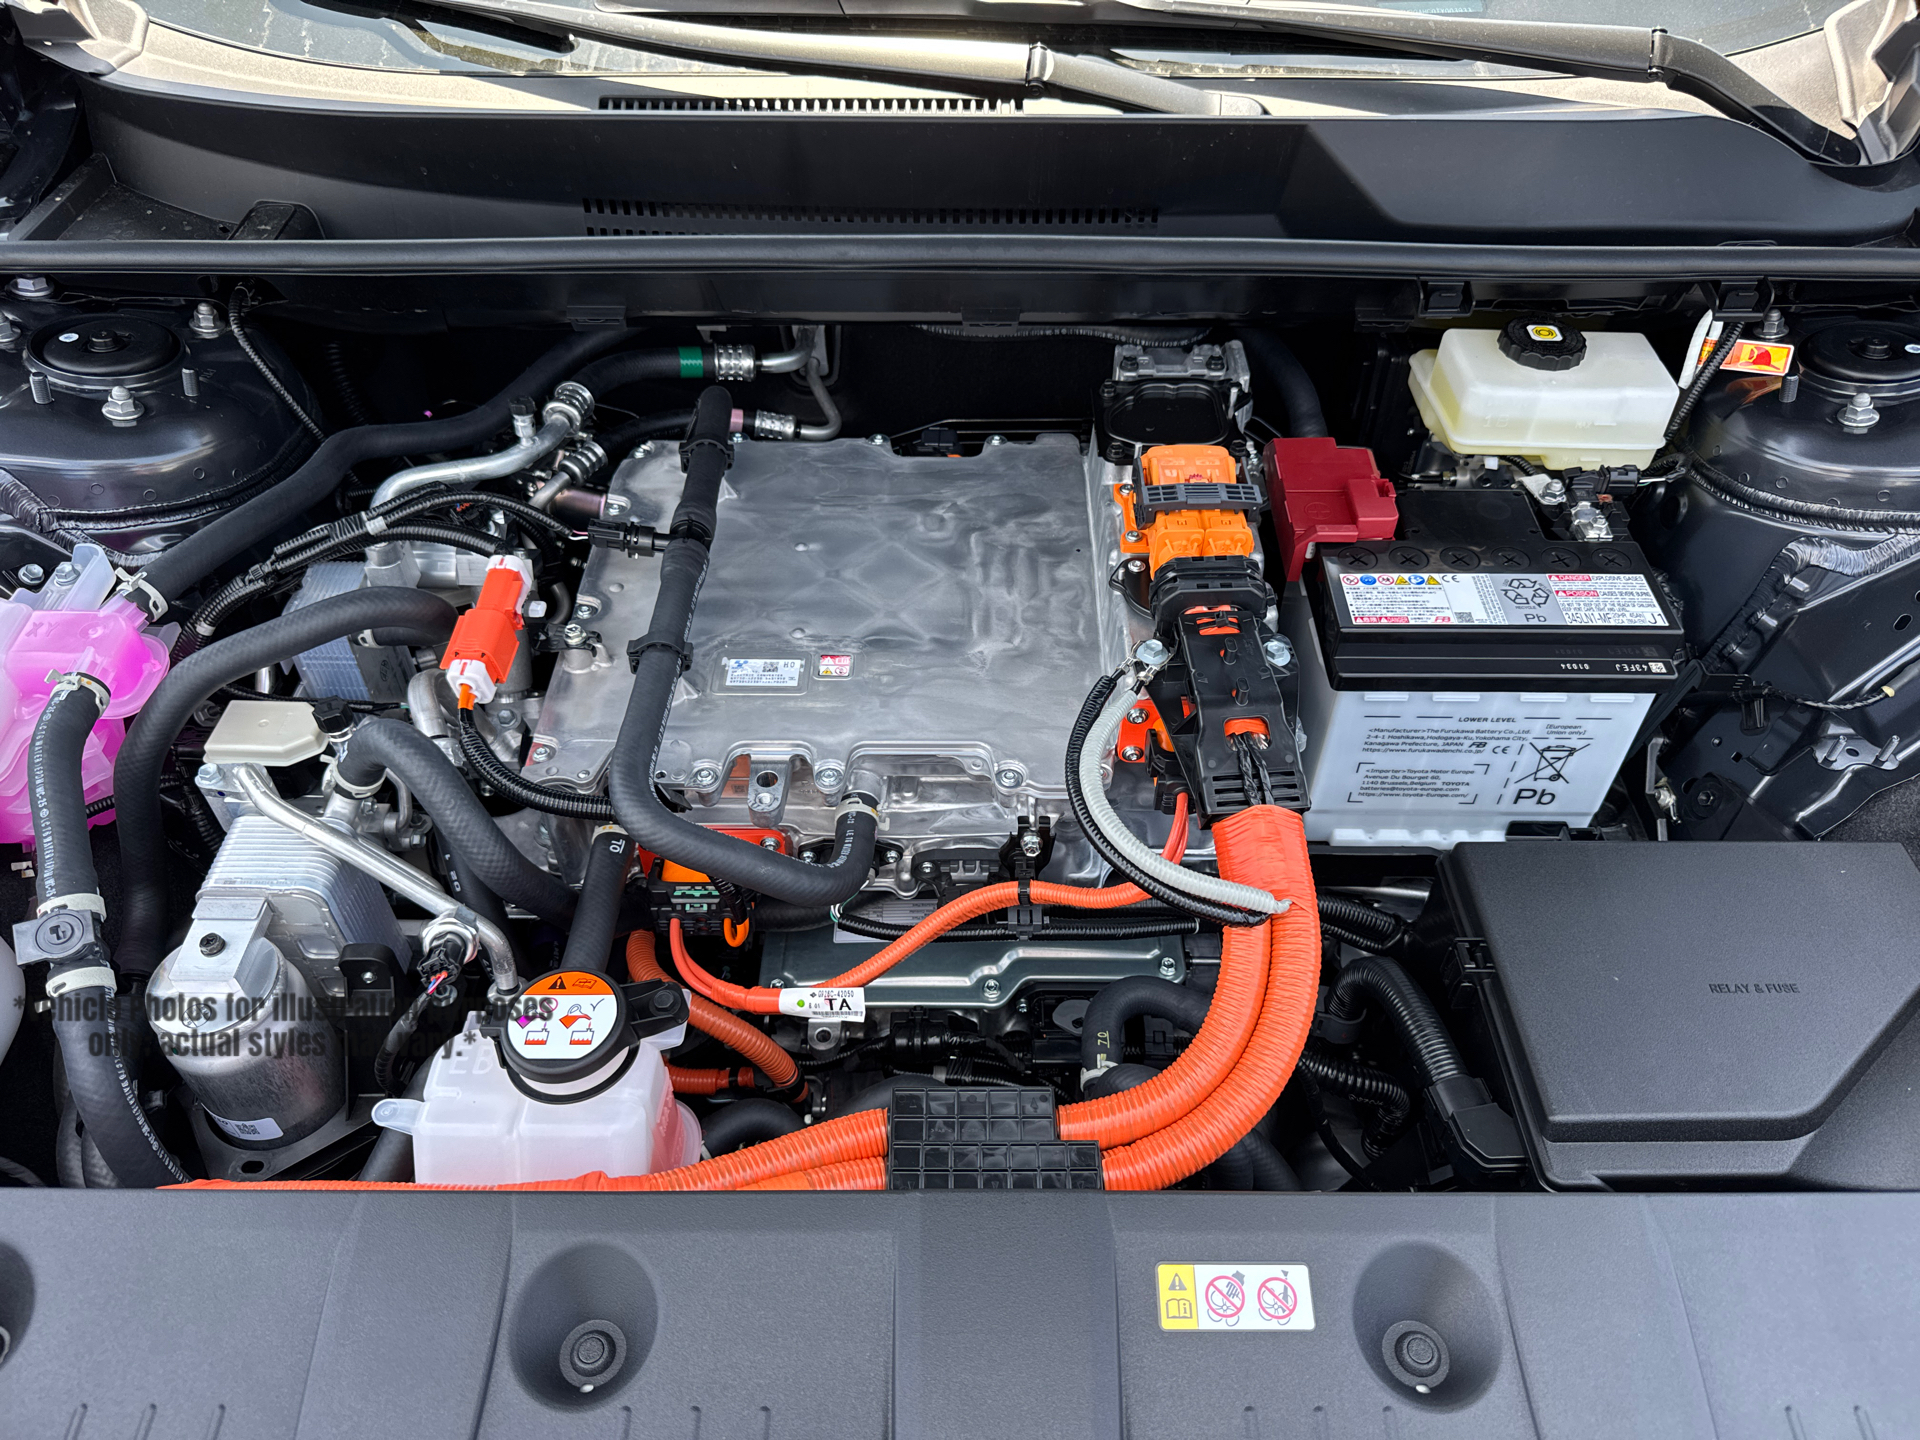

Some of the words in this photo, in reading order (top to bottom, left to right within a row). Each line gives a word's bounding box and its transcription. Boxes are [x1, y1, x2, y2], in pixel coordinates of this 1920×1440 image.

[1524, 613, 1547, 622] Pb
[25, 622, 60, 638] XY
[1512, 788, 1556, 805] Pb
[1708, 984, 1750, 994] RELAY
[1754, 984, 1764, 994] &
[1765, 984, 1800, 994] FUSE
[824, 998, 852, 1011] TA
